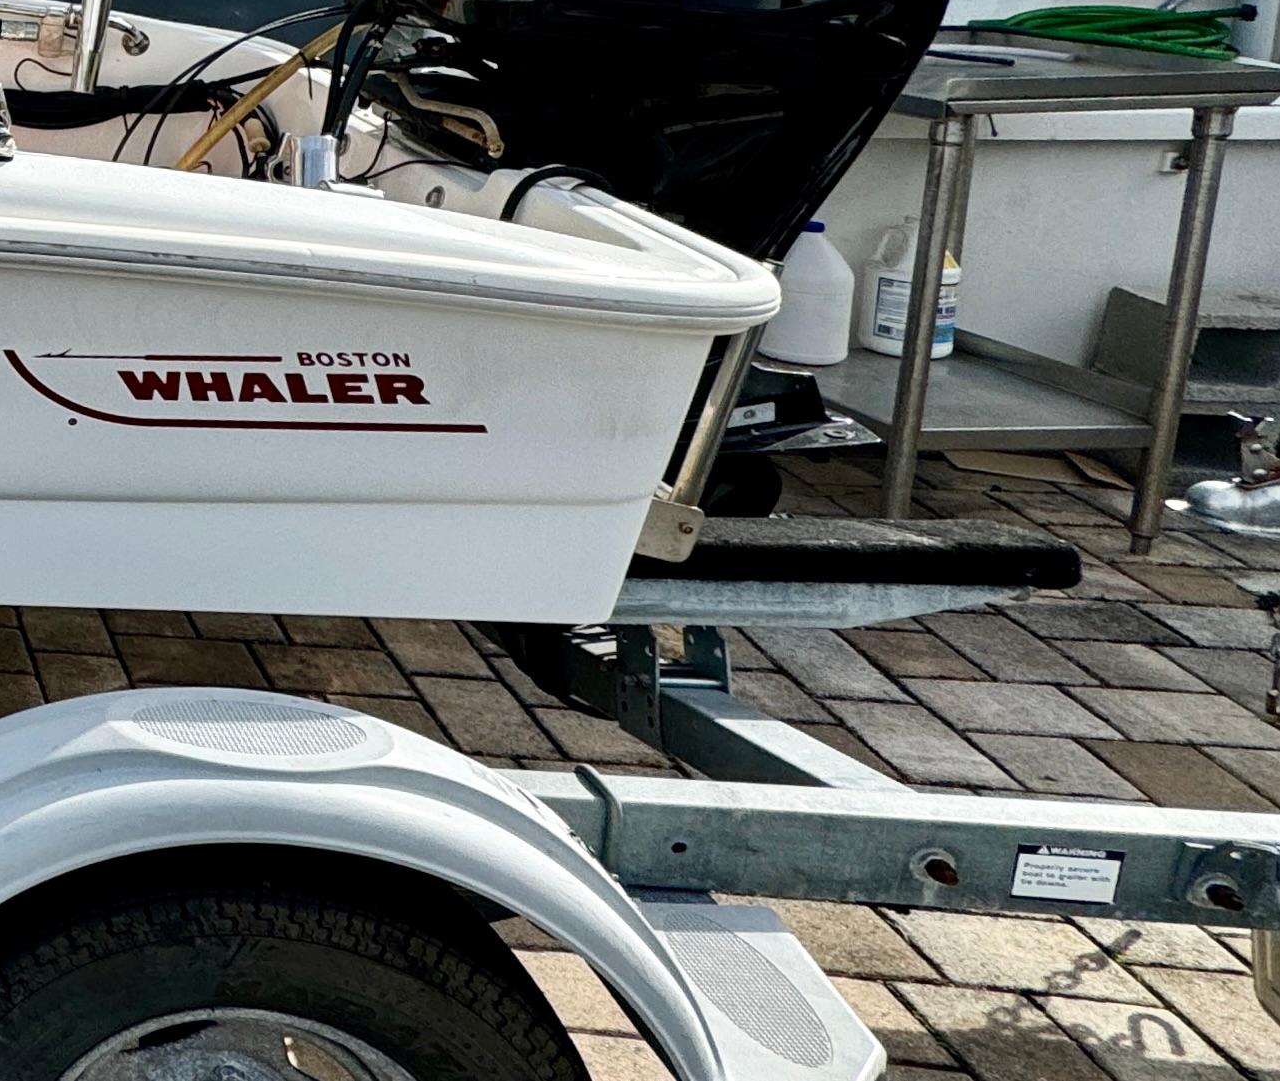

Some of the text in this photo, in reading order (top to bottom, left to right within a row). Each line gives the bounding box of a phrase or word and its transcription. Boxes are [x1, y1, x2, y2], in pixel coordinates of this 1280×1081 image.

[296, 351, 413, 369] BOSTON
[117, 370, 432, 406] WHALER
[1050, 847, 1107, 859] WARNING
[1024, 862, 1064, 873] Properly
